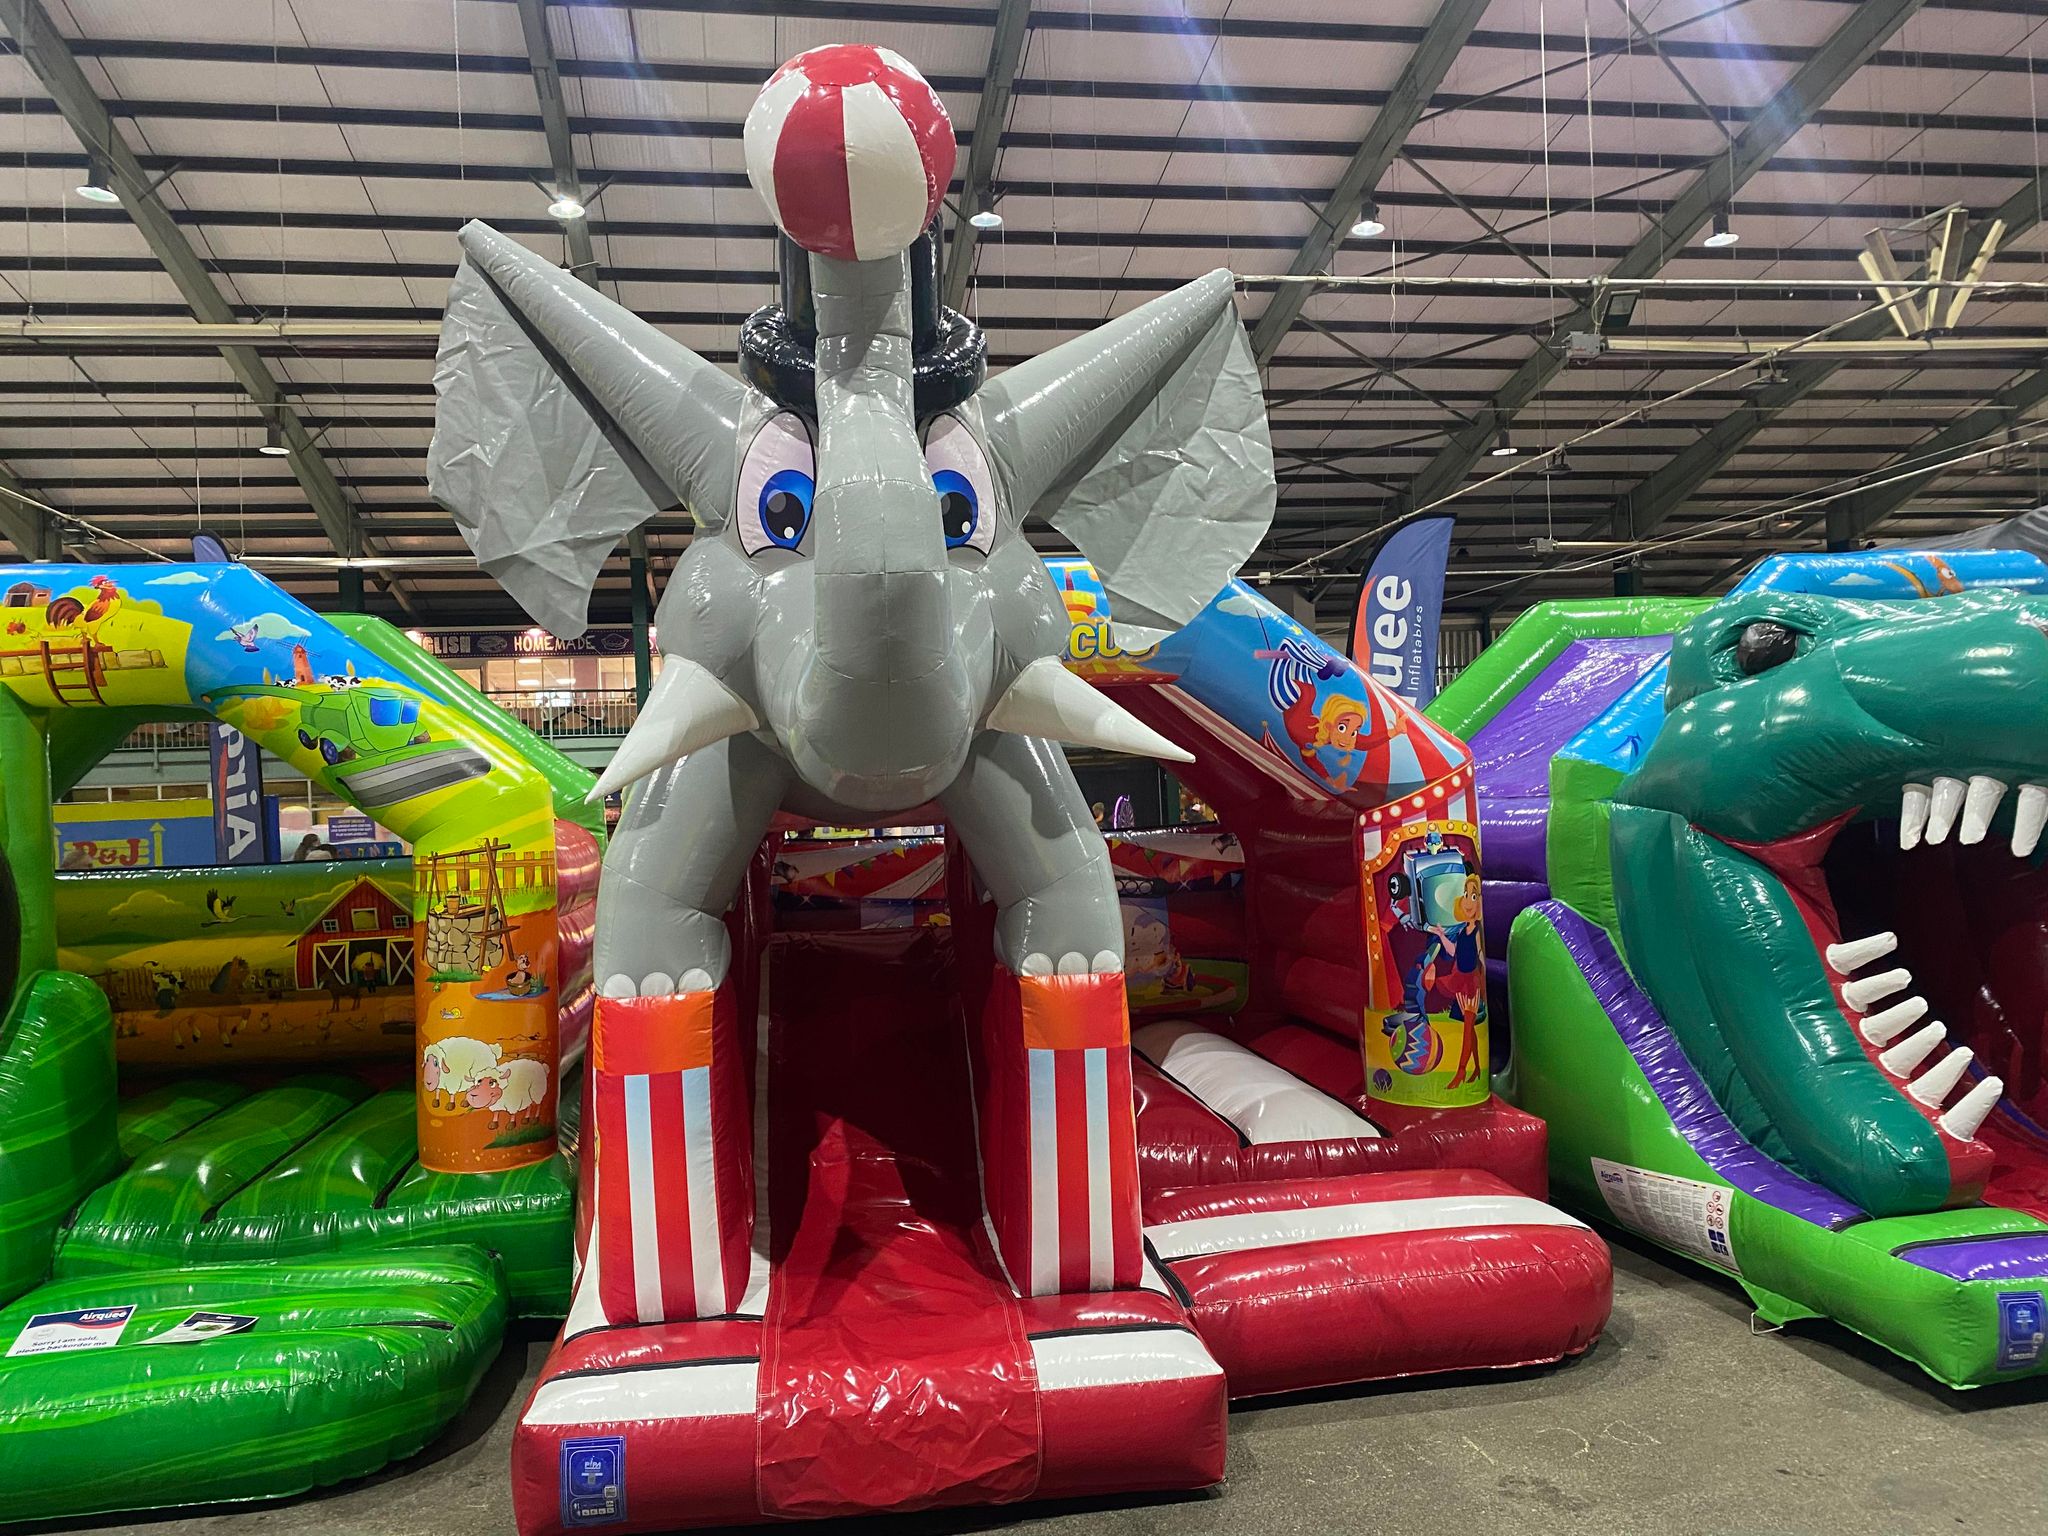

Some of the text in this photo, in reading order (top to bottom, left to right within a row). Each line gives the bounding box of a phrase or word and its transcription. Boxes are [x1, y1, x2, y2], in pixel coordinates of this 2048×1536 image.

[416, 634, 596, 654] GLISH HOMEMADE
[1407, 605, 1424, 691] Inflatables
